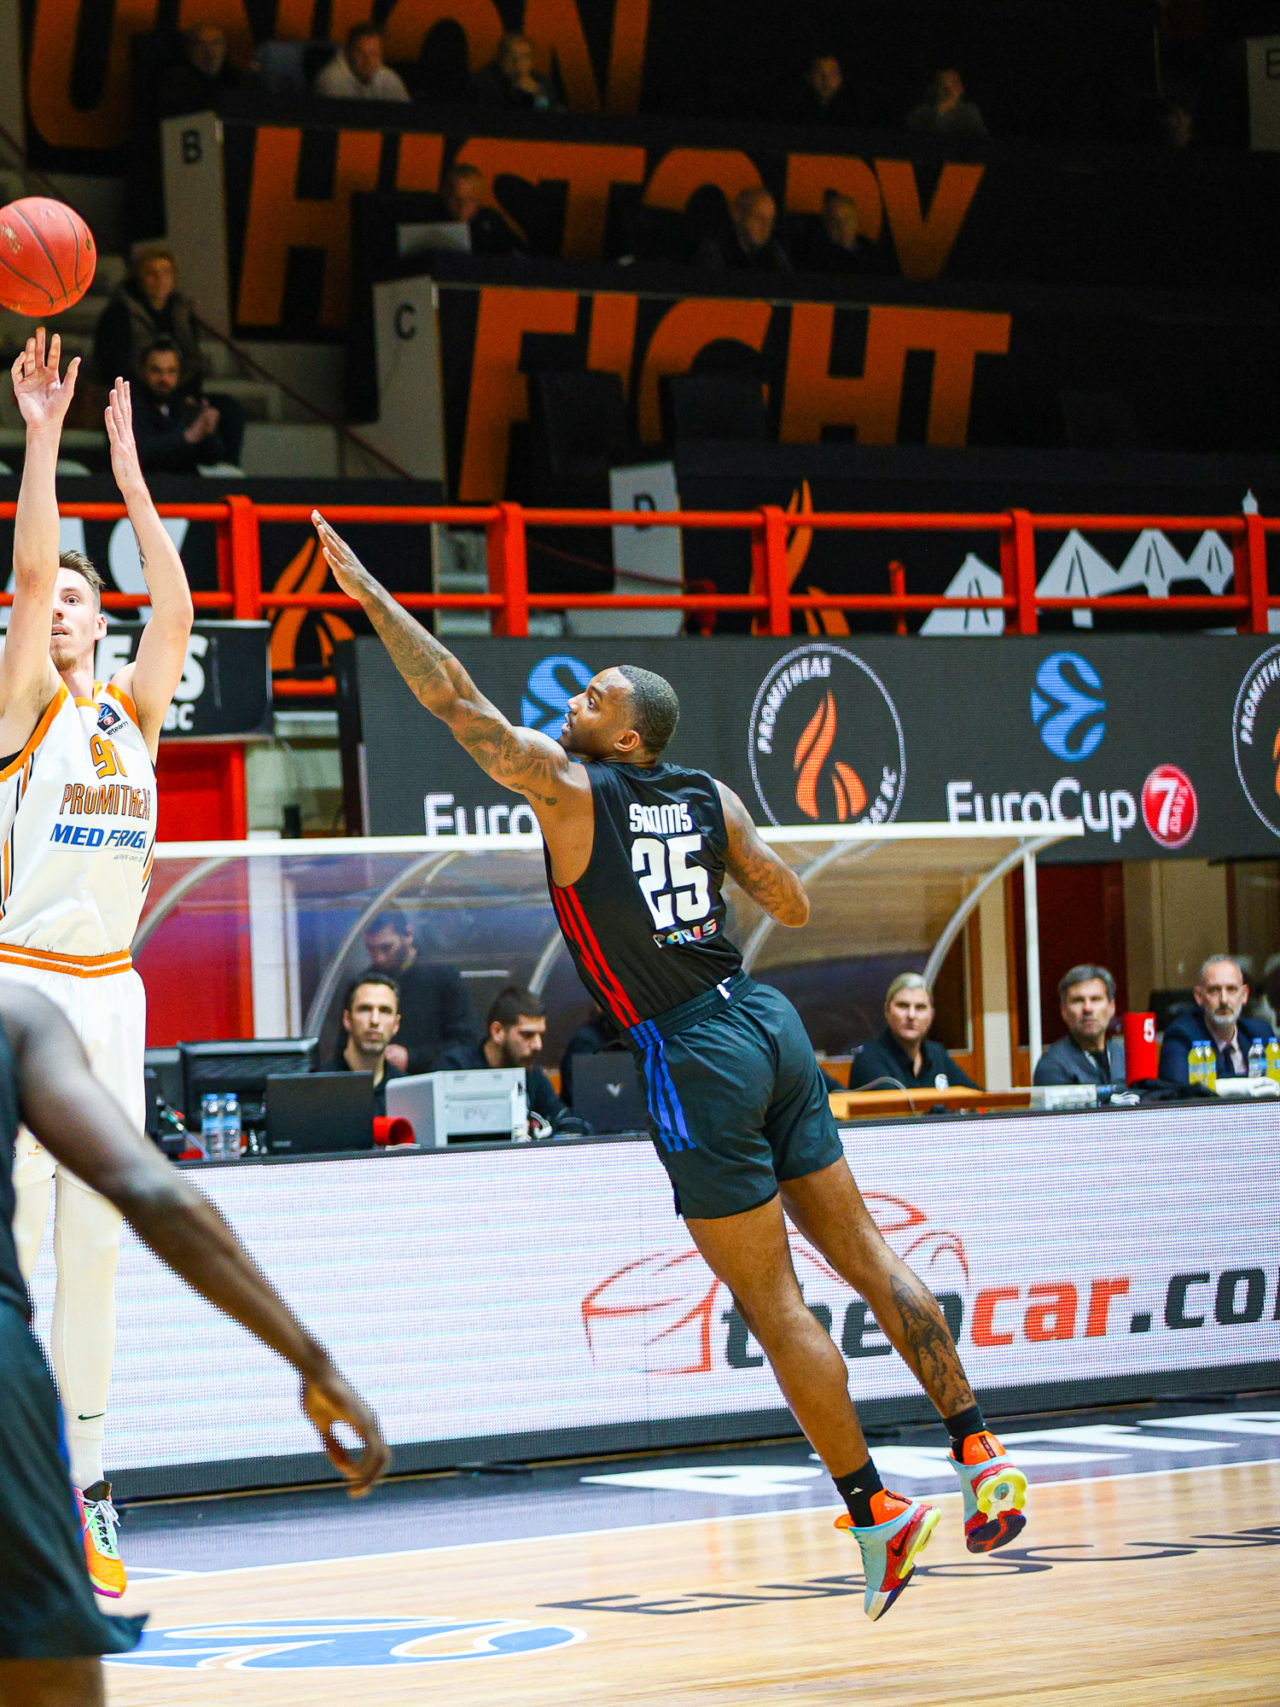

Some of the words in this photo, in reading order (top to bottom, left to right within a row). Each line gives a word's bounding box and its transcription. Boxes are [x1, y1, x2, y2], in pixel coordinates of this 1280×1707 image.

[181, 129, 204, 166] B
[393, 303, 417, 341] C
[1239, 656, 1280, 745] PROMITH
[423, 792, 542, 836] Euro
[946, 777, 1137, 843] EuroCup
[49, 823, 104, 848] MED
[105, 829, 148, 849] FRIG
[631, 834, 712, 930] 25
[1143, 1018, 1156, 1043] 5
[721, 1266, 1280, 1370] tecar.co
